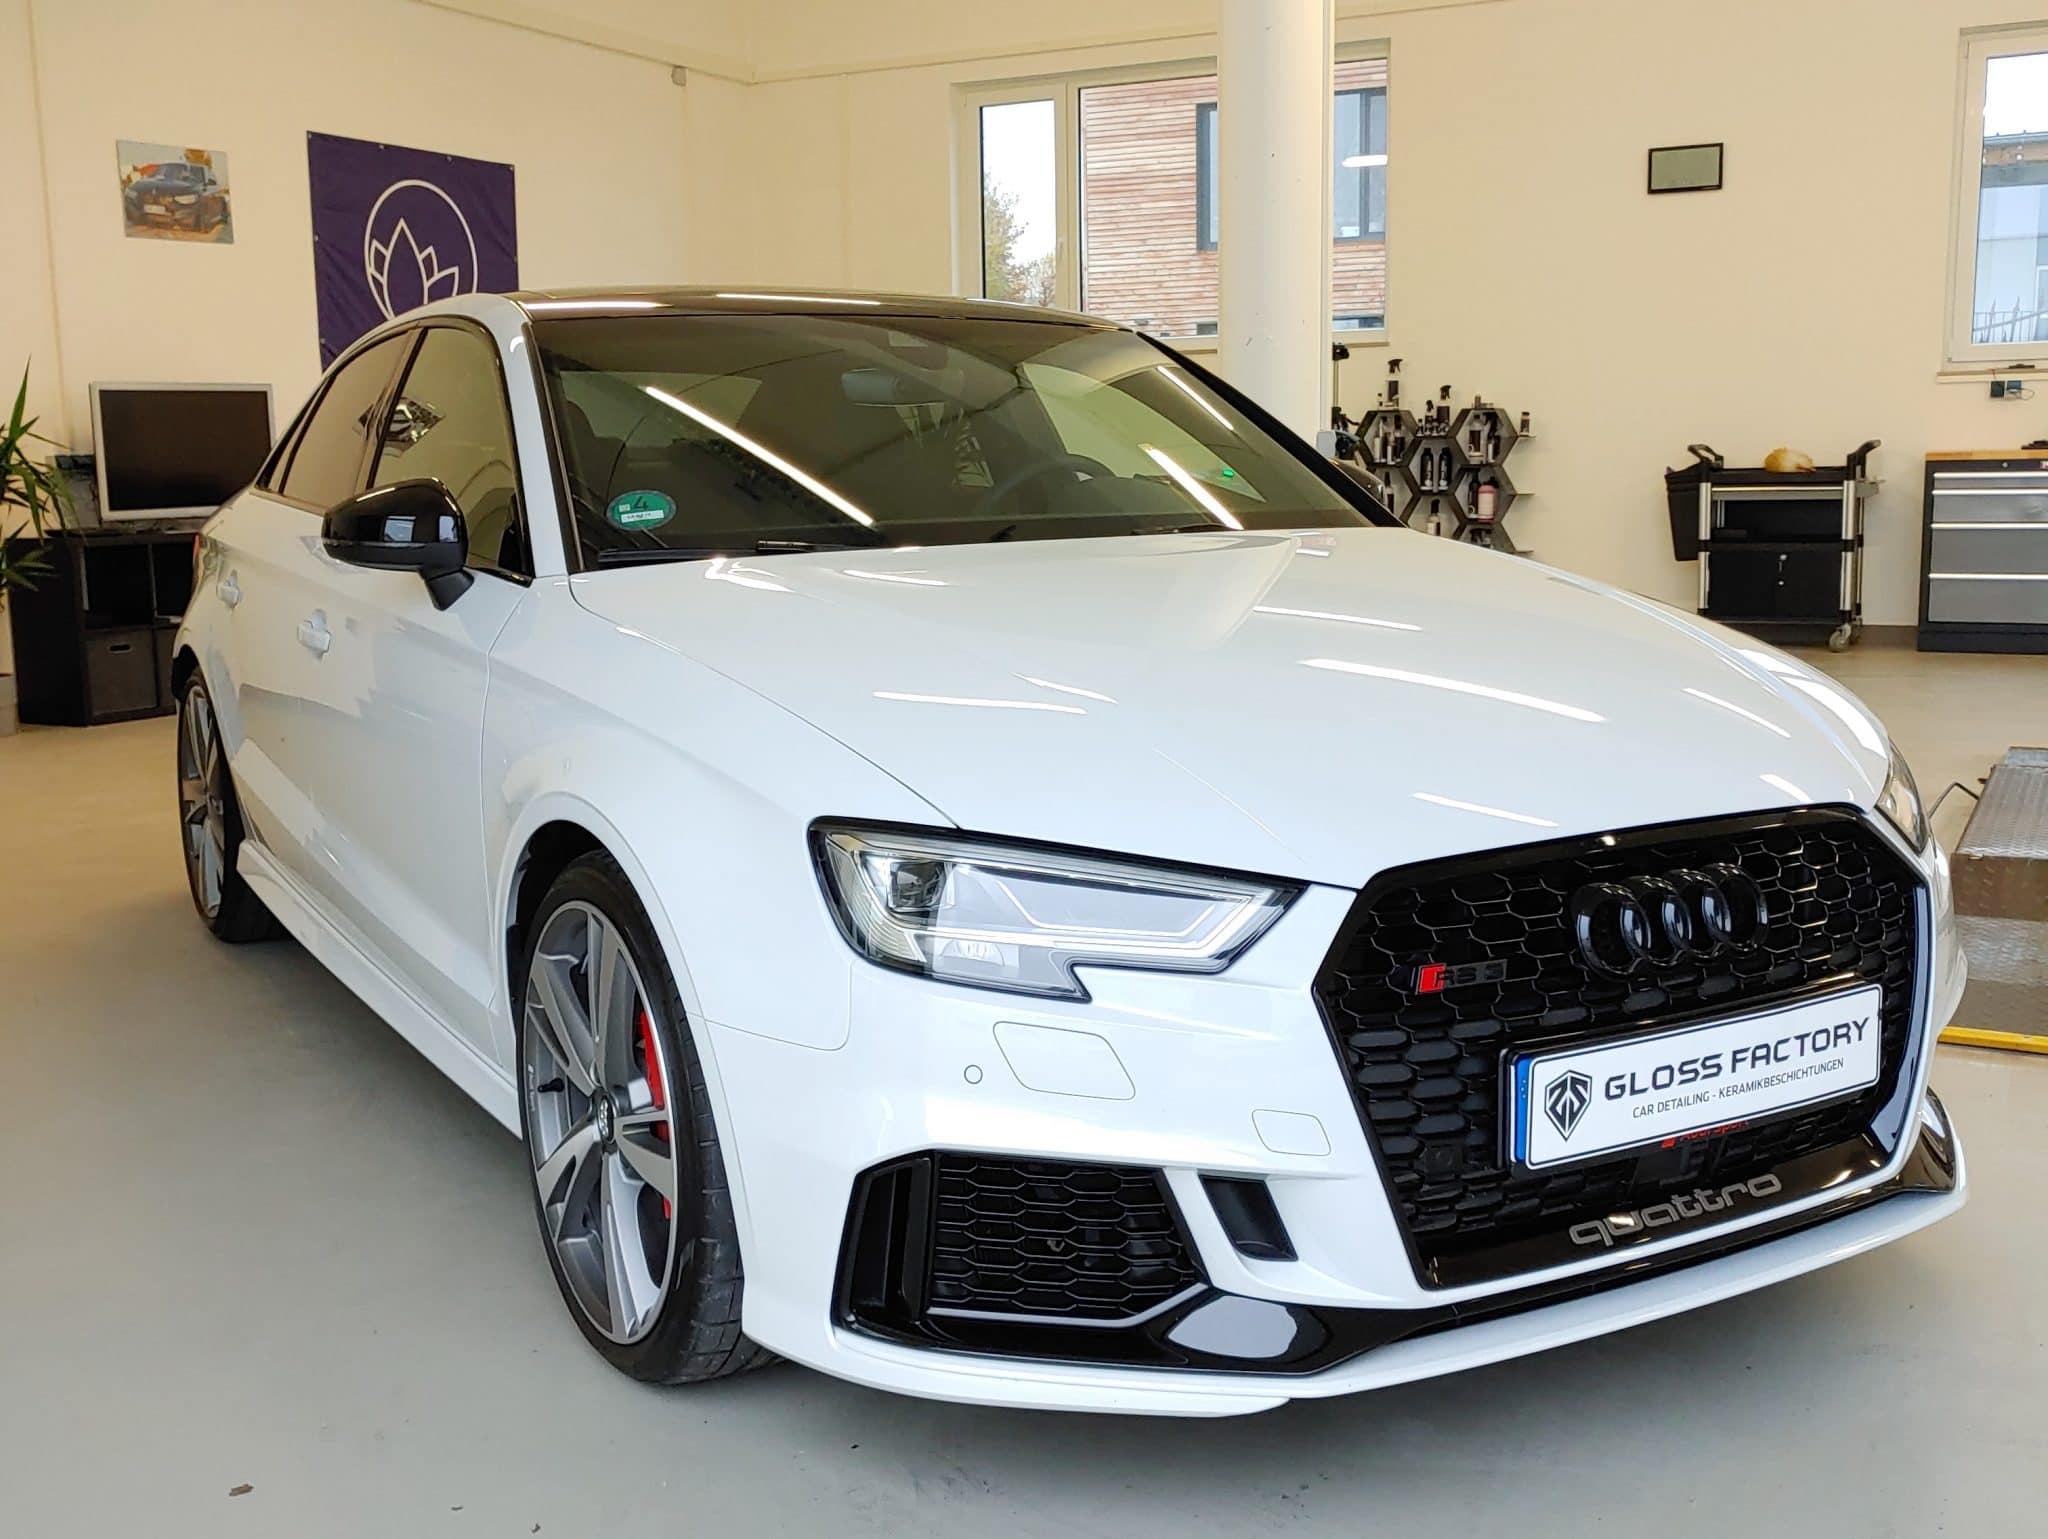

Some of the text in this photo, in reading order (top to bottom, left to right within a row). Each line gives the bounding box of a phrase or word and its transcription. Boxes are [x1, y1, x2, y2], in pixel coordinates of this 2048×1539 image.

[633, 496, 648, 510] 4
[1605, 1017, 1869, 1100] GLOSS FACTORY
[1633, 1104, 1654, 1118] CAR
[1657, 1091, 1710, 1113] DETAILING
[1718, 1057, 1844, 1099] KERAMIKBESCHICHTUNGEN
[1569, 1174, 1782, 1247] quattro
